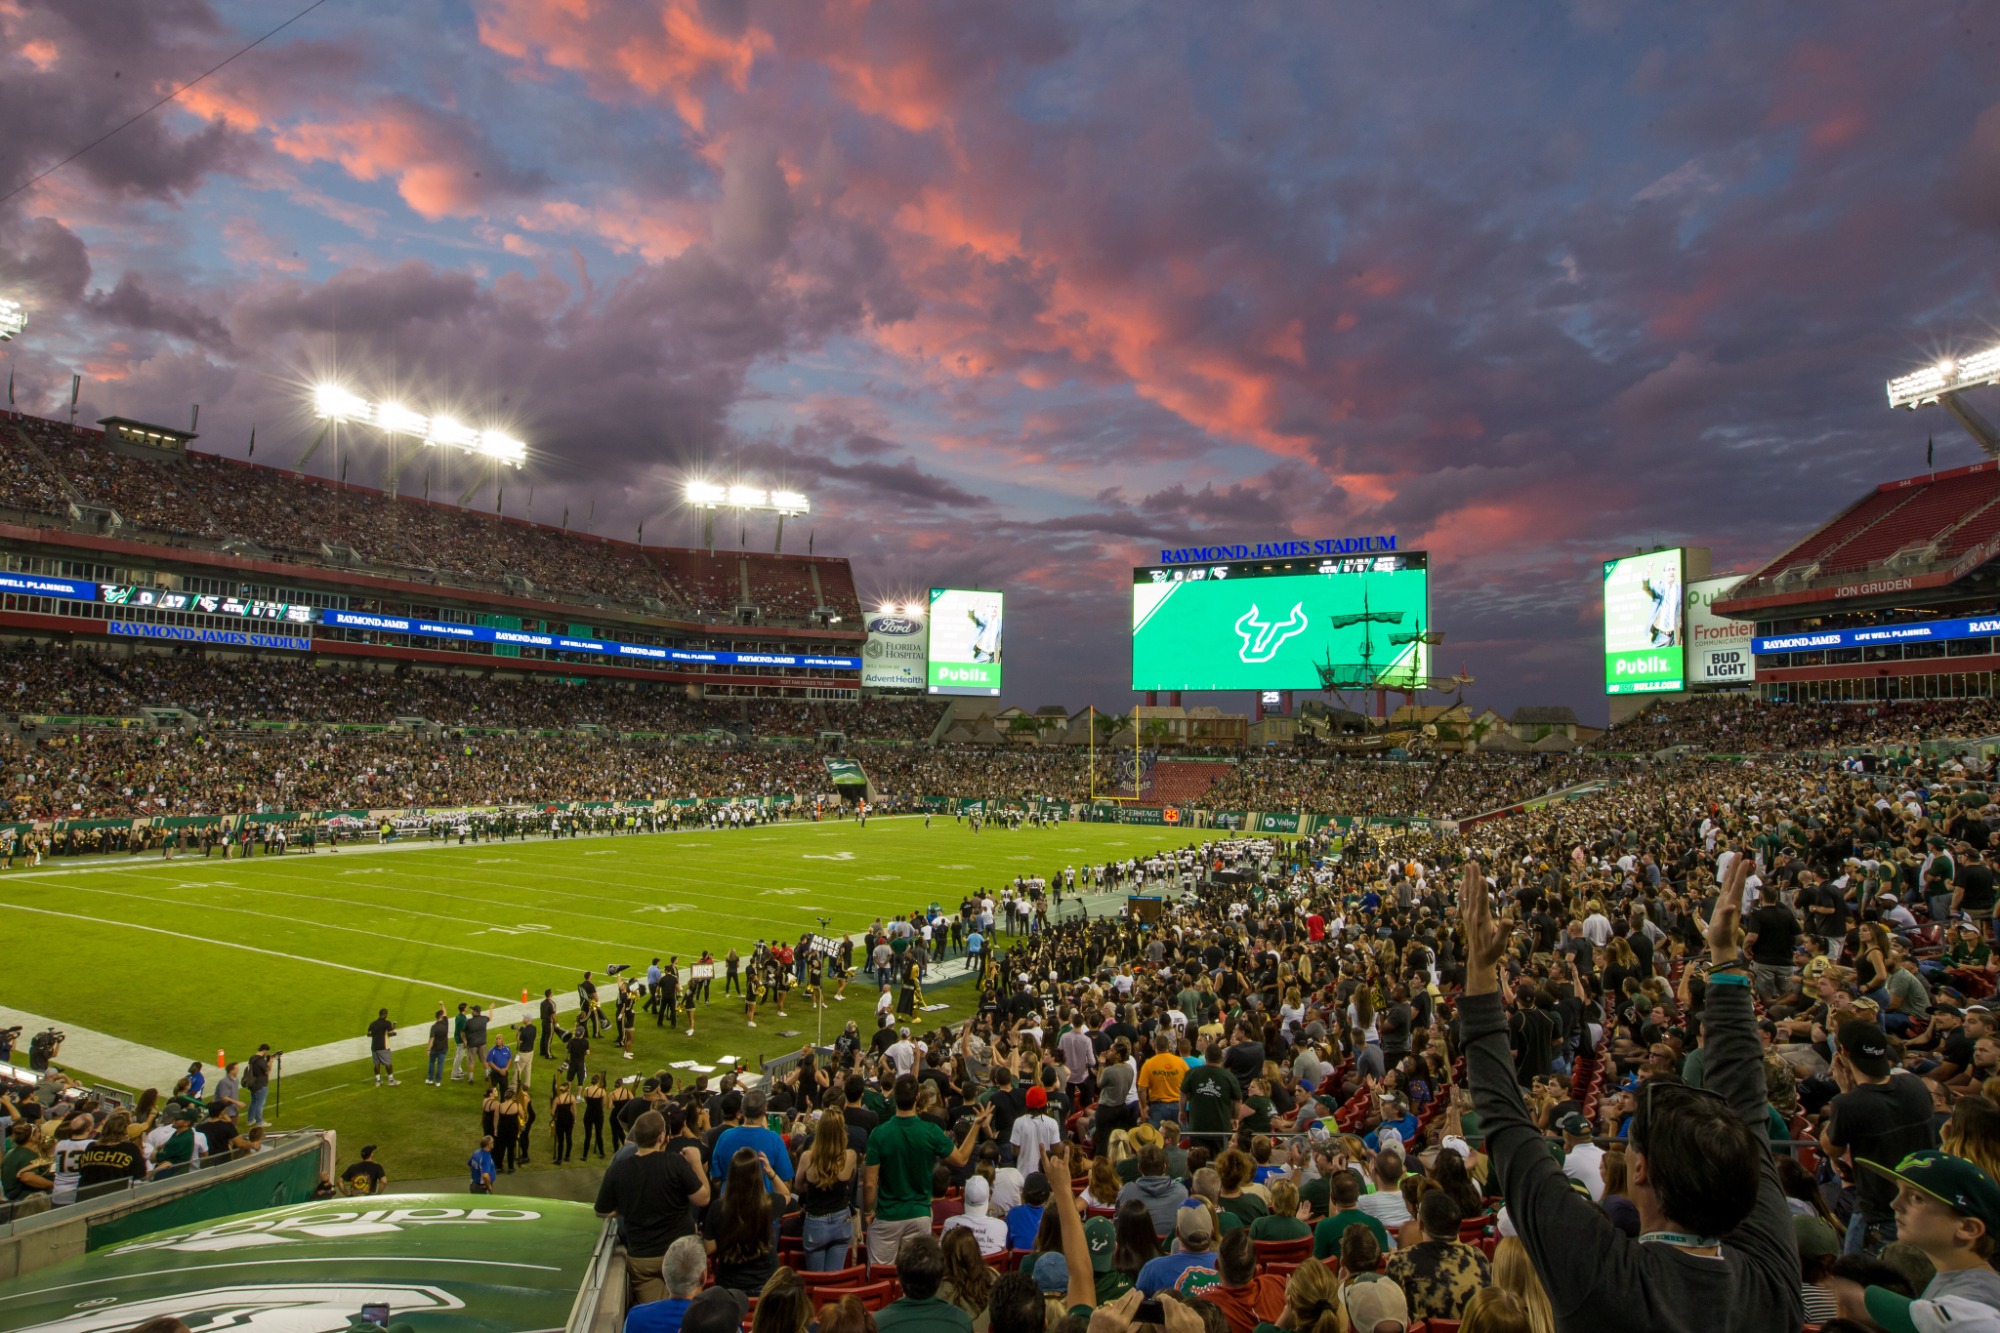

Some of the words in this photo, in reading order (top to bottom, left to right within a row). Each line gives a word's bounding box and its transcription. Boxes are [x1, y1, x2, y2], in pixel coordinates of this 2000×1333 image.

[1160, 545, 1248, 563] RAYMOND
[1251, 540, 1310, 558] JAMES
[1313, 535, 1397, 554] STADIUM
[1191, 570, 1206, 580] 17
[0, 578, 25, 588] WELL
[26, 581, 75, 593] PLANNED.
[1835, 585, 1858, 598] JON
[1860, 578, 1912, 594] GRUDEN
[141, 592, 153, 605] 0
[166, 595, 186, 608] 17
[222, 603, 244, 613] 4TH
[337, 614, 381, 627] RAYMOND
[382, 619, 409, 630] JAMES
[432, 625, 447, 633] WELL
[879, 619, 911, 633] Ford
[110, 621, 195, 640] RAYMOND
[197, 629, 247, 645] JAMES
[250, 634, 310, 650] STADIUM
[495, 632, 531, 643] RAYMOND
[530, 635, 552, 645] JAMES
[1694, 622, 1754, 641] Frontier
[1763, 638, 1809, 649] RAYMOND
[1809, 634, 1841, 645] JAMES
[1855, 633, 1870, 641] LIFE
[1871, 631, 1891, 640] WELL
[1892, 628, 1932, 637] PLANNED.
[886, 642, 921, 651] FLORIDA
[737, 655, 773, 663] RAYMOND
[772, 656, 796, 664] JAMES
[885, 650, 925, 660] HOSPITAL
[1711, 651, 1740, 665] BUD
[1706, 663, 1746, 677] LIGHT
[865, 673, 923, 684] AdventHealth
[1262, 691, 1279, 703] 25
[1165, 811, 1177, 820] 25
[1276, 818, 1298, 828] Valley
[812, 934, 842, 949] MAKE
[810, 943, 838, 958] NOISE
[57, 1150, 85, 1173] 13
[81, 1151, 133, 1167] NIGHTS
